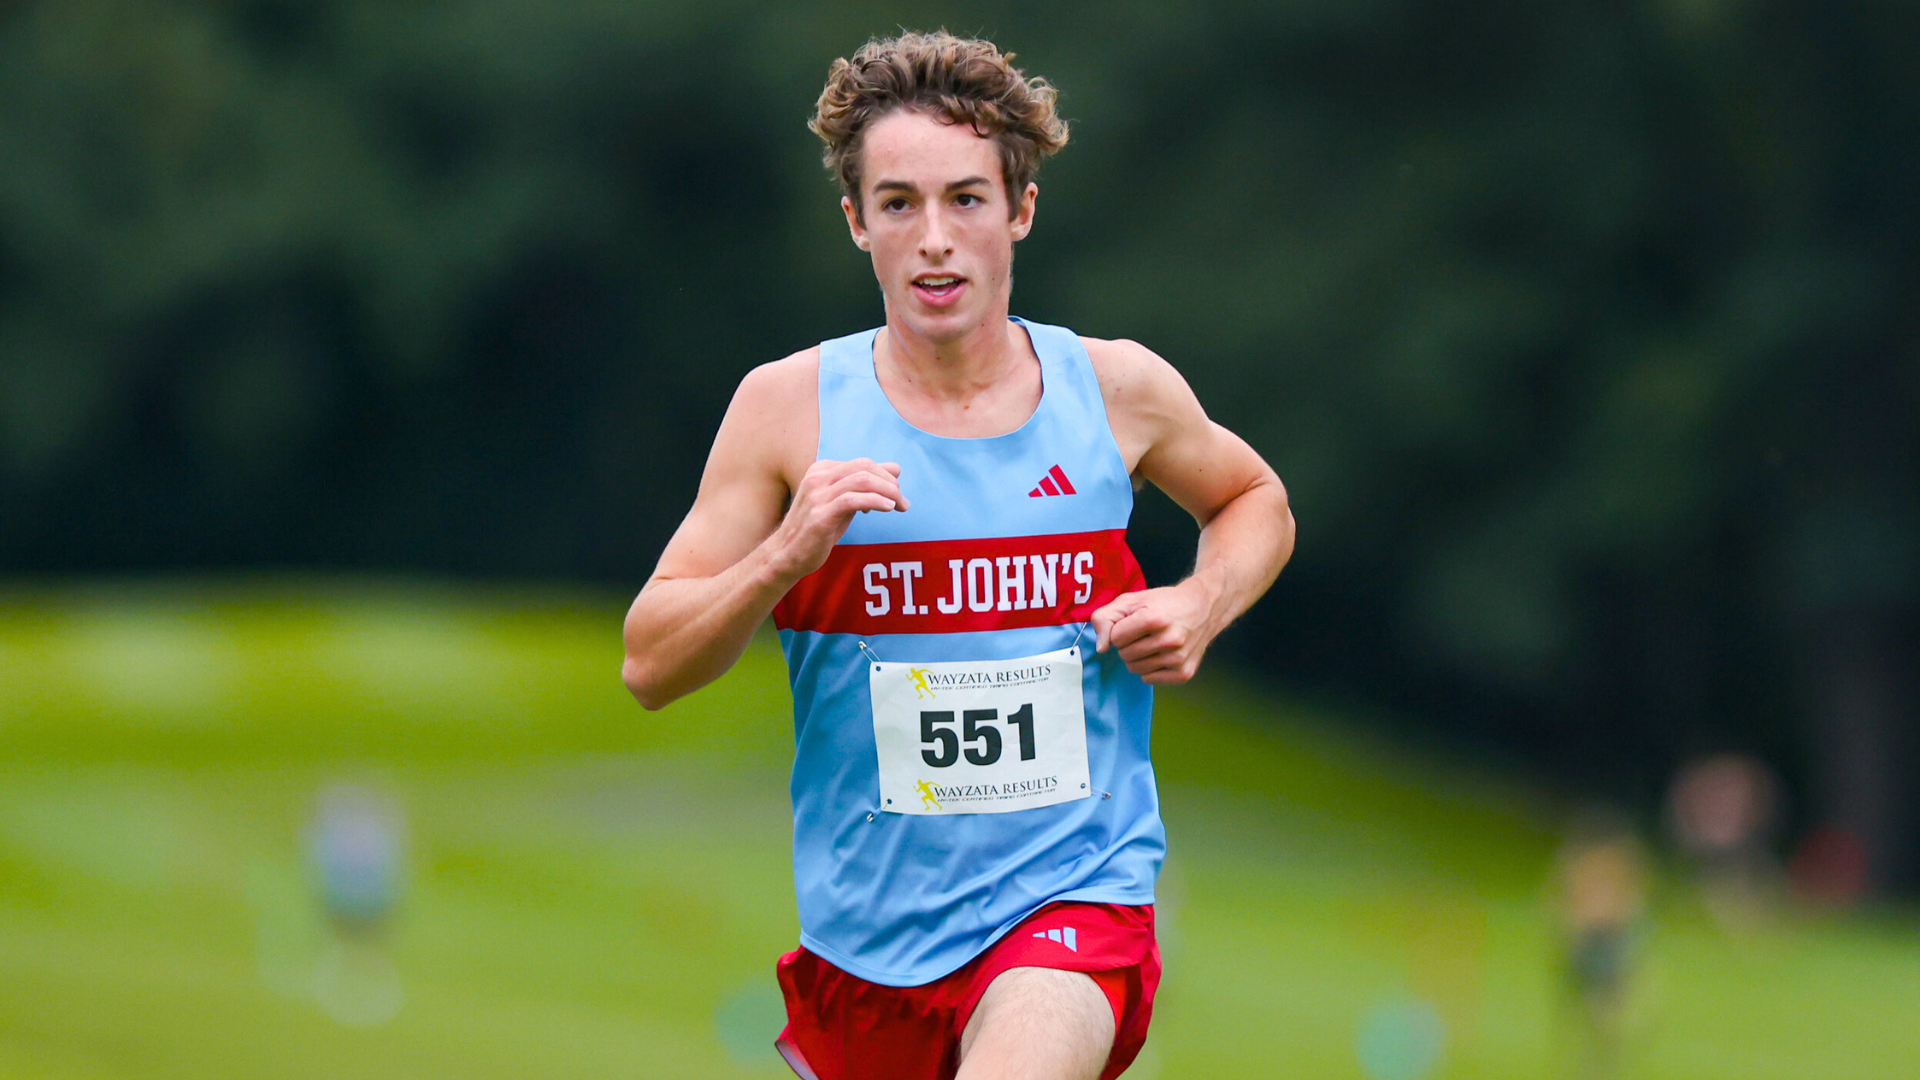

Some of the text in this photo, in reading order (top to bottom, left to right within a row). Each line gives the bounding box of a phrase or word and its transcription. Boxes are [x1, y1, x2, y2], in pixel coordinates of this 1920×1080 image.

[862, 551, 1094, 617] ST. JOHN'S
[928, 664, 1051, 685] WAYZATA RESULTS
[920, 703, 1036, 768] 551
[934, 775, 1058, 797] WAYZATA RESULTS
